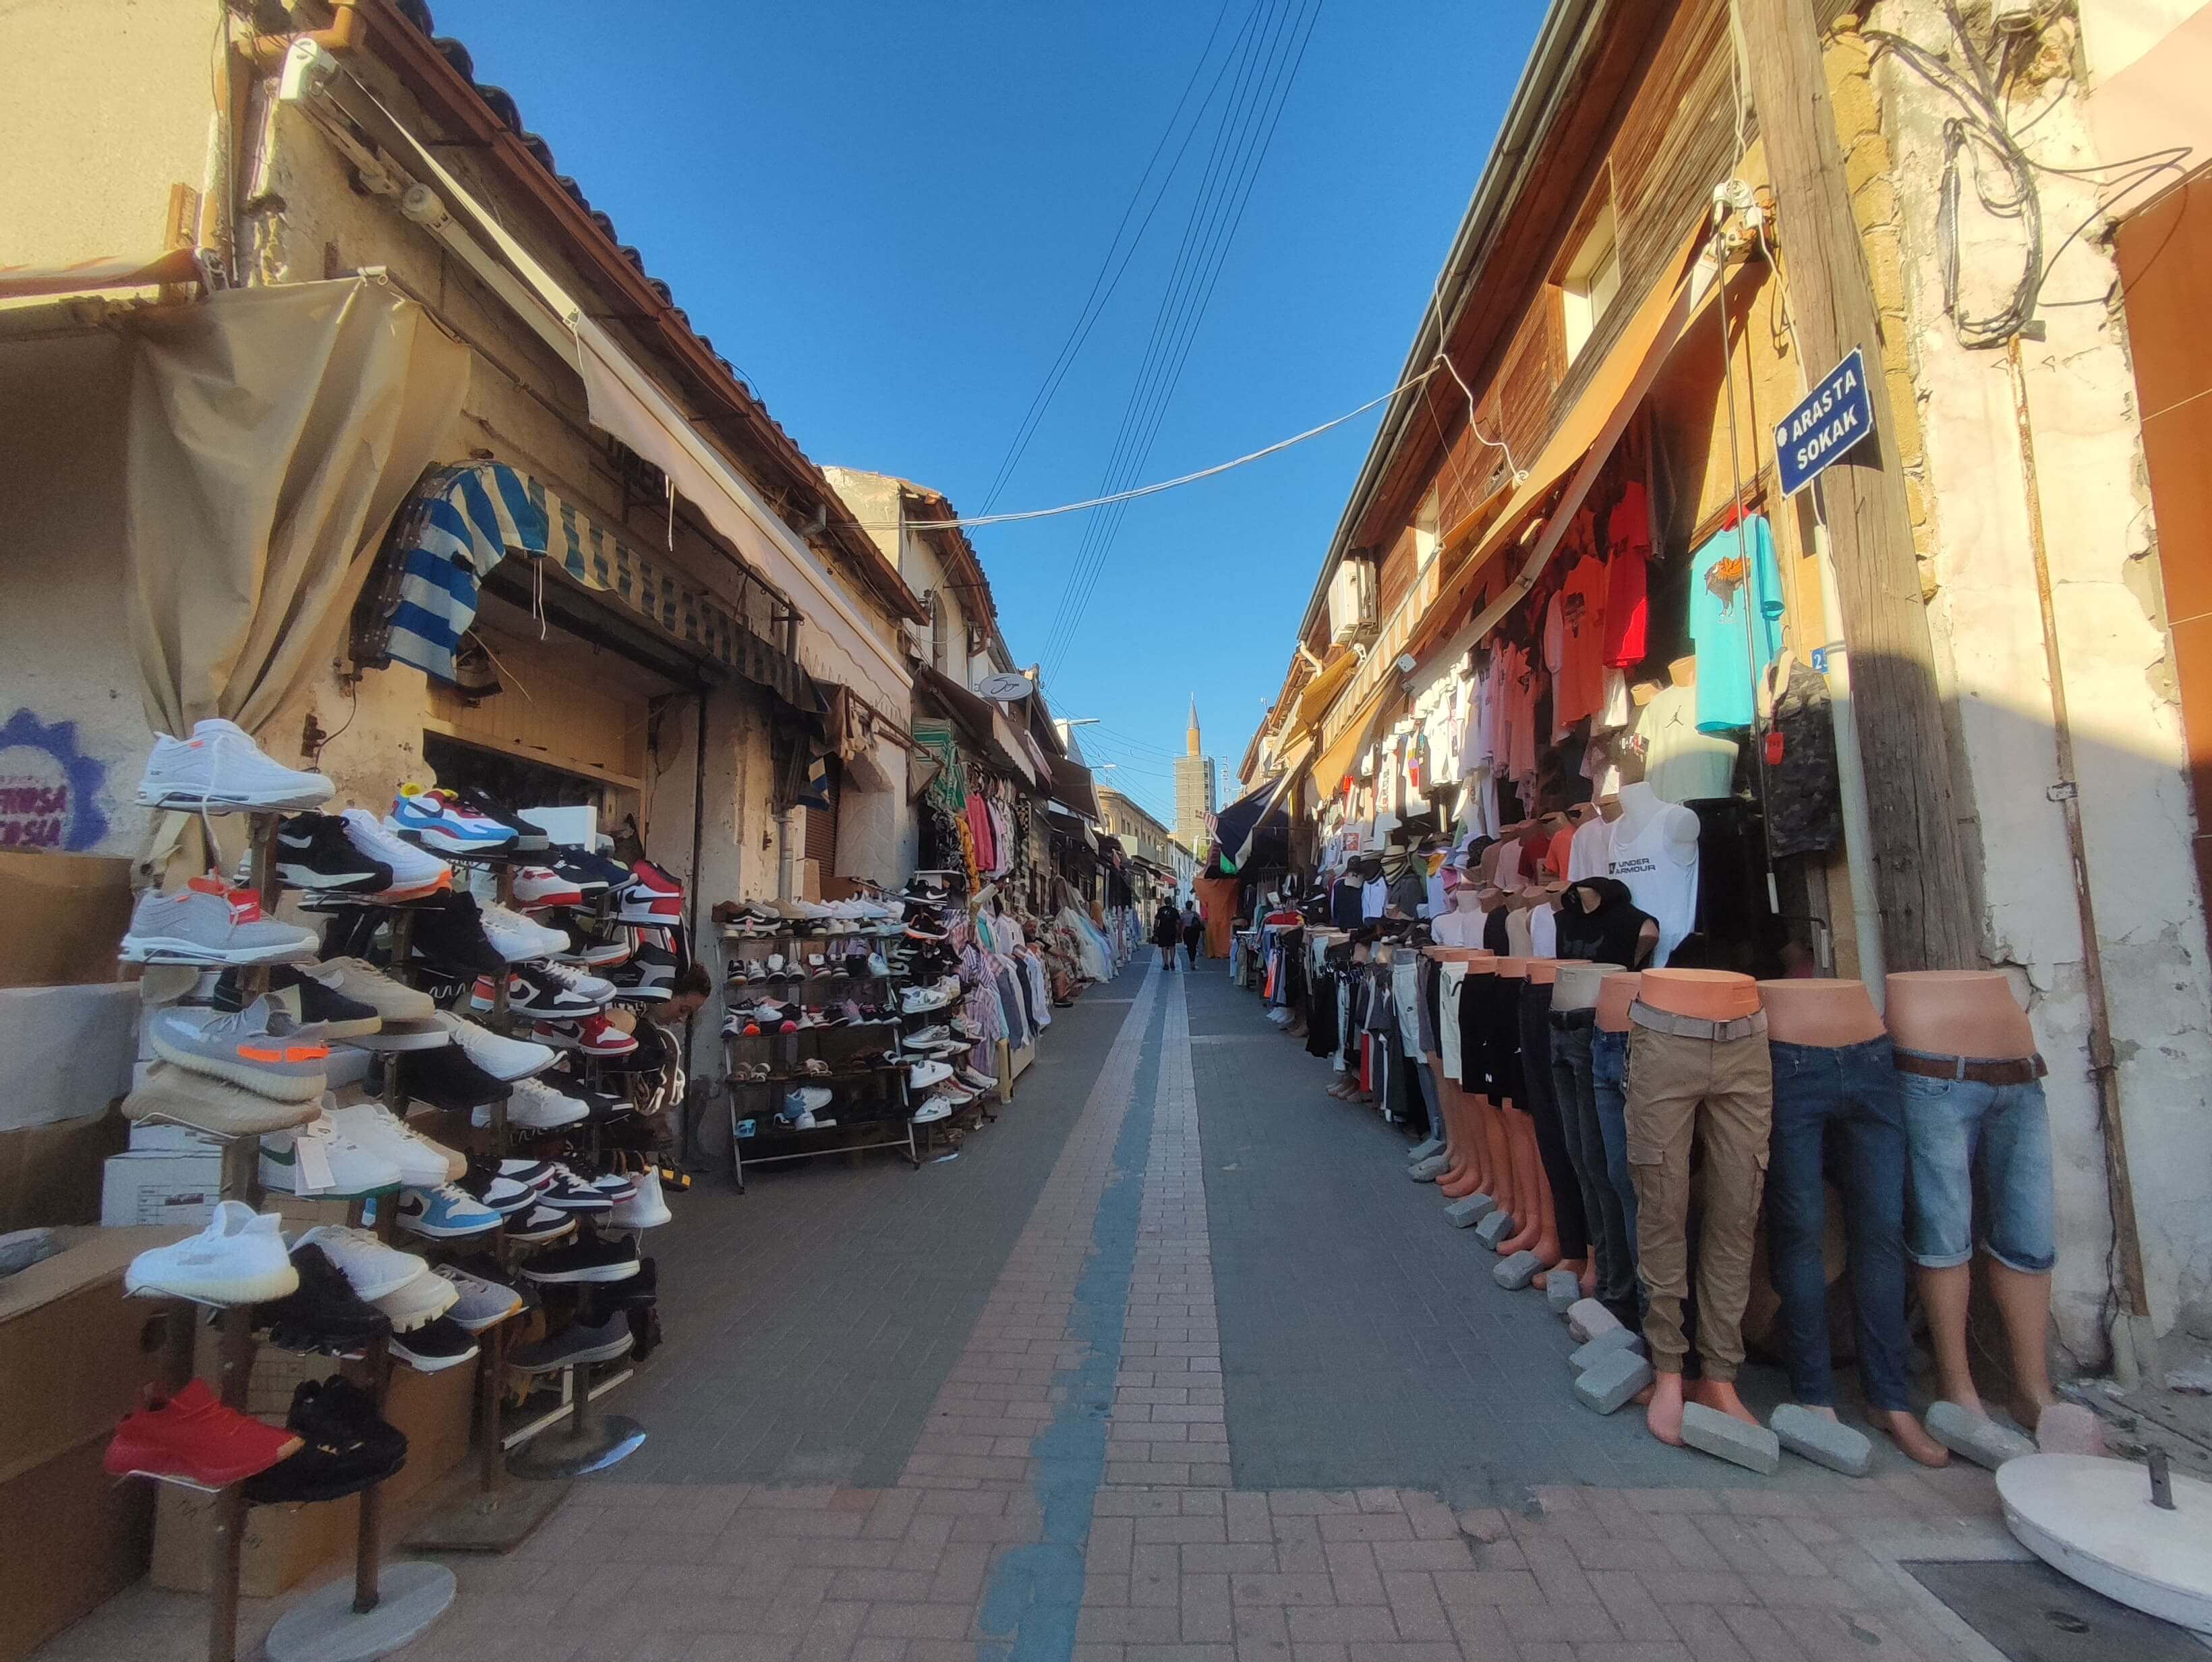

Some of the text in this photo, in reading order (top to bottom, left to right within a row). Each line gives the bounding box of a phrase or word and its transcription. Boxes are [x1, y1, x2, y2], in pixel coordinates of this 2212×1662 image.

[1793, 369, 1857, 442] ARASTA
[1797, 403, 1858, 470] SOKAK
[1615, 864, 1656, 875] ARMOUR
[1618, 857, 1650, 867] UNDER
